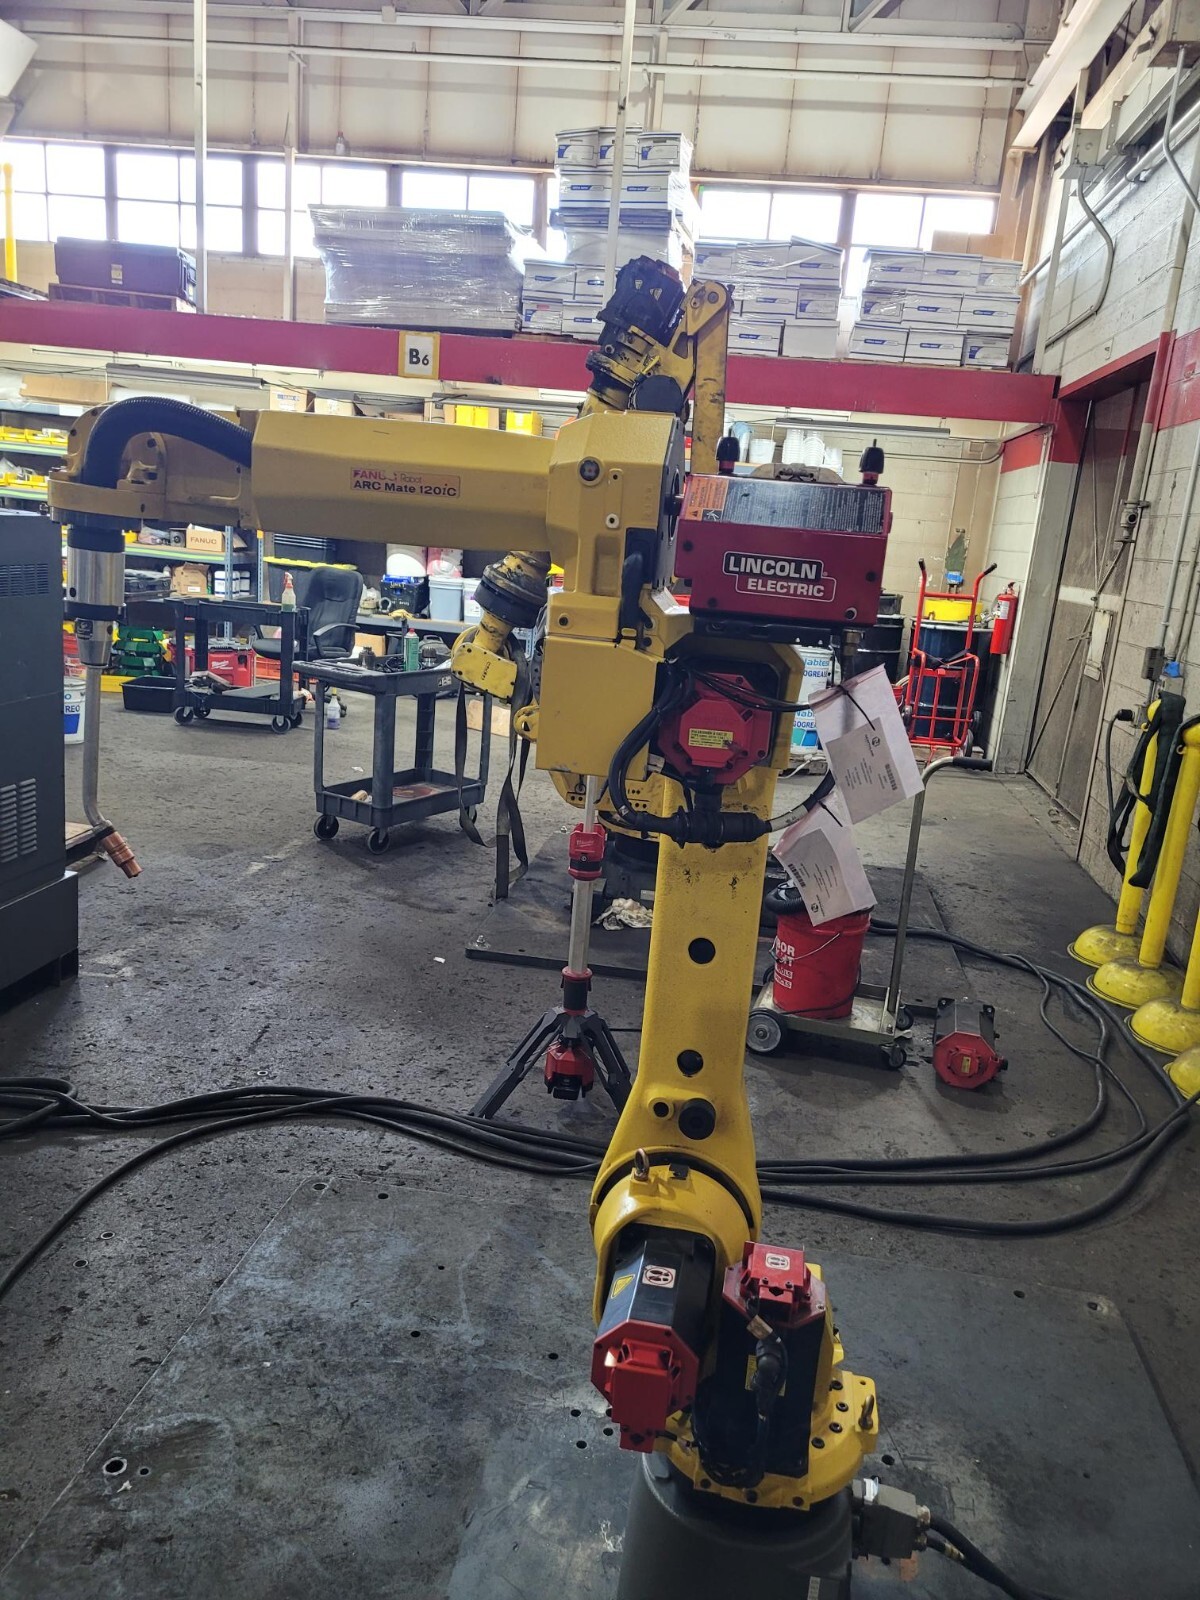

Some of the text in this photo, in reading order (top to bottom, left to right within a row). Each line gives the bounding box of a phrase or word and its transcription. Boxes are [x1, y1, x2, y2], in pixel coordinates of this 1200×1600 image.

[409, 348, 430, 366] B6
[354, 480, 457, 497] ARC Mate 120iC
[190, 536, 217, 545] FANUC
[729, 556, 817, 580] LINCOLN
[747, 578, 825, 597] ELECTRIC
